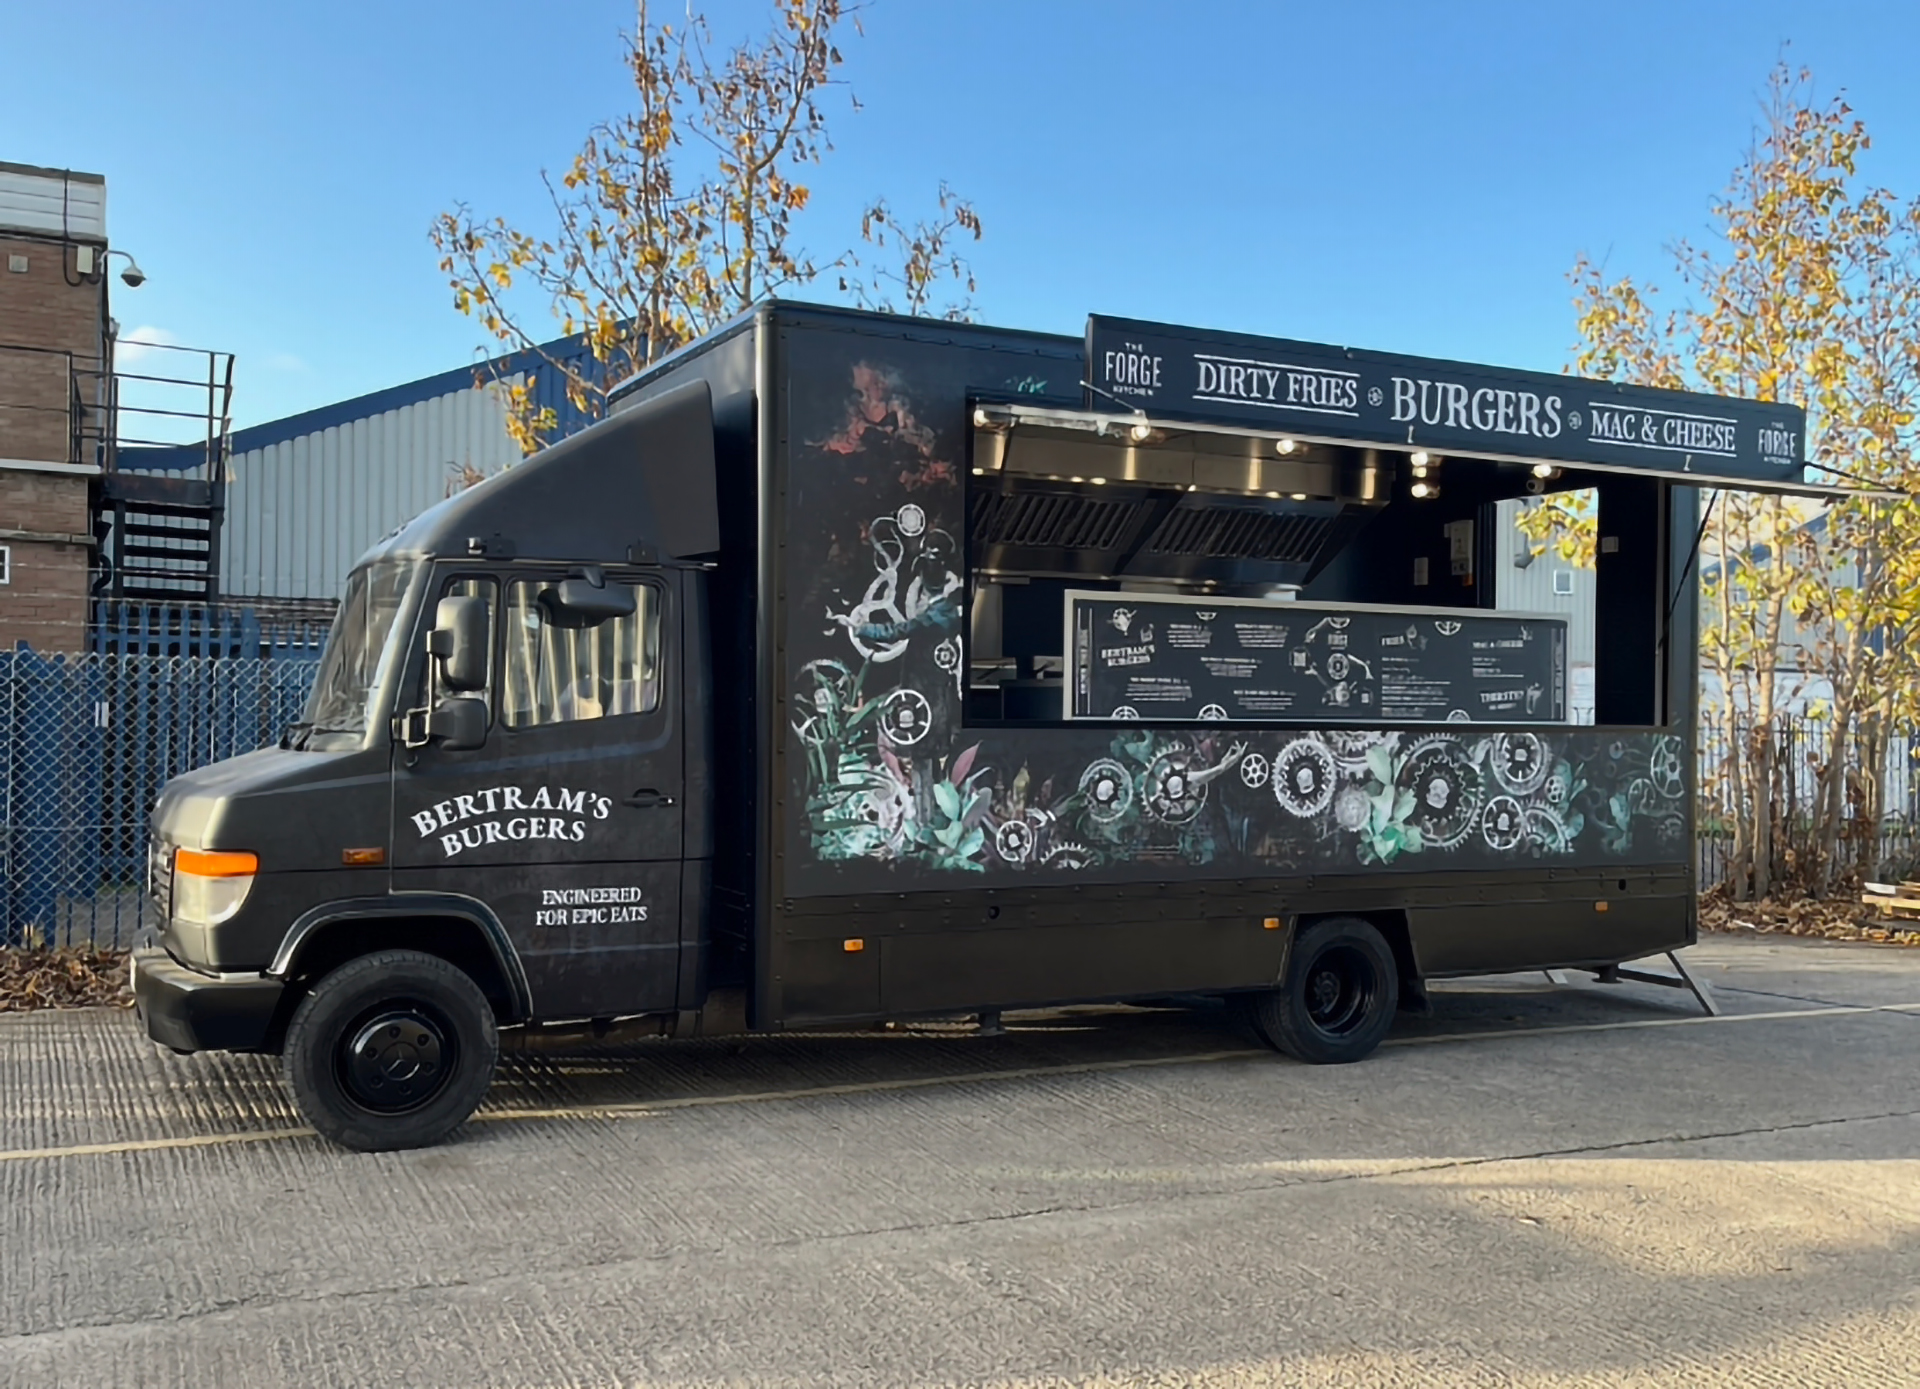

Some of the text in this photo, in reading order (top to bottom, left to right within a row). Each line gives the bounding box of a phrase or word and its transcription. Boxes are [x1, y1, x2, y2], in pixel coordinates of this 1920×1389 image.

[1125, 342, 1143, 353] THE
[1105, 351, 1163, 387] FORGE
[1196, 361, 1358, 409] DIRTY FRIES
[1390, 376, 1563, 439] BURGERS
[1589, 409, 1736, 452] MAC & CHEESE
[1758, 428, 1797, 458] FORGE
[410, 786, 613, 838] BERTRAM'S
[439, 817, 587, 858] BURGERS
[542, 887, 642, 905] ENGINEERED
[536, 906, 648, 926] FOR EPIC EATS
